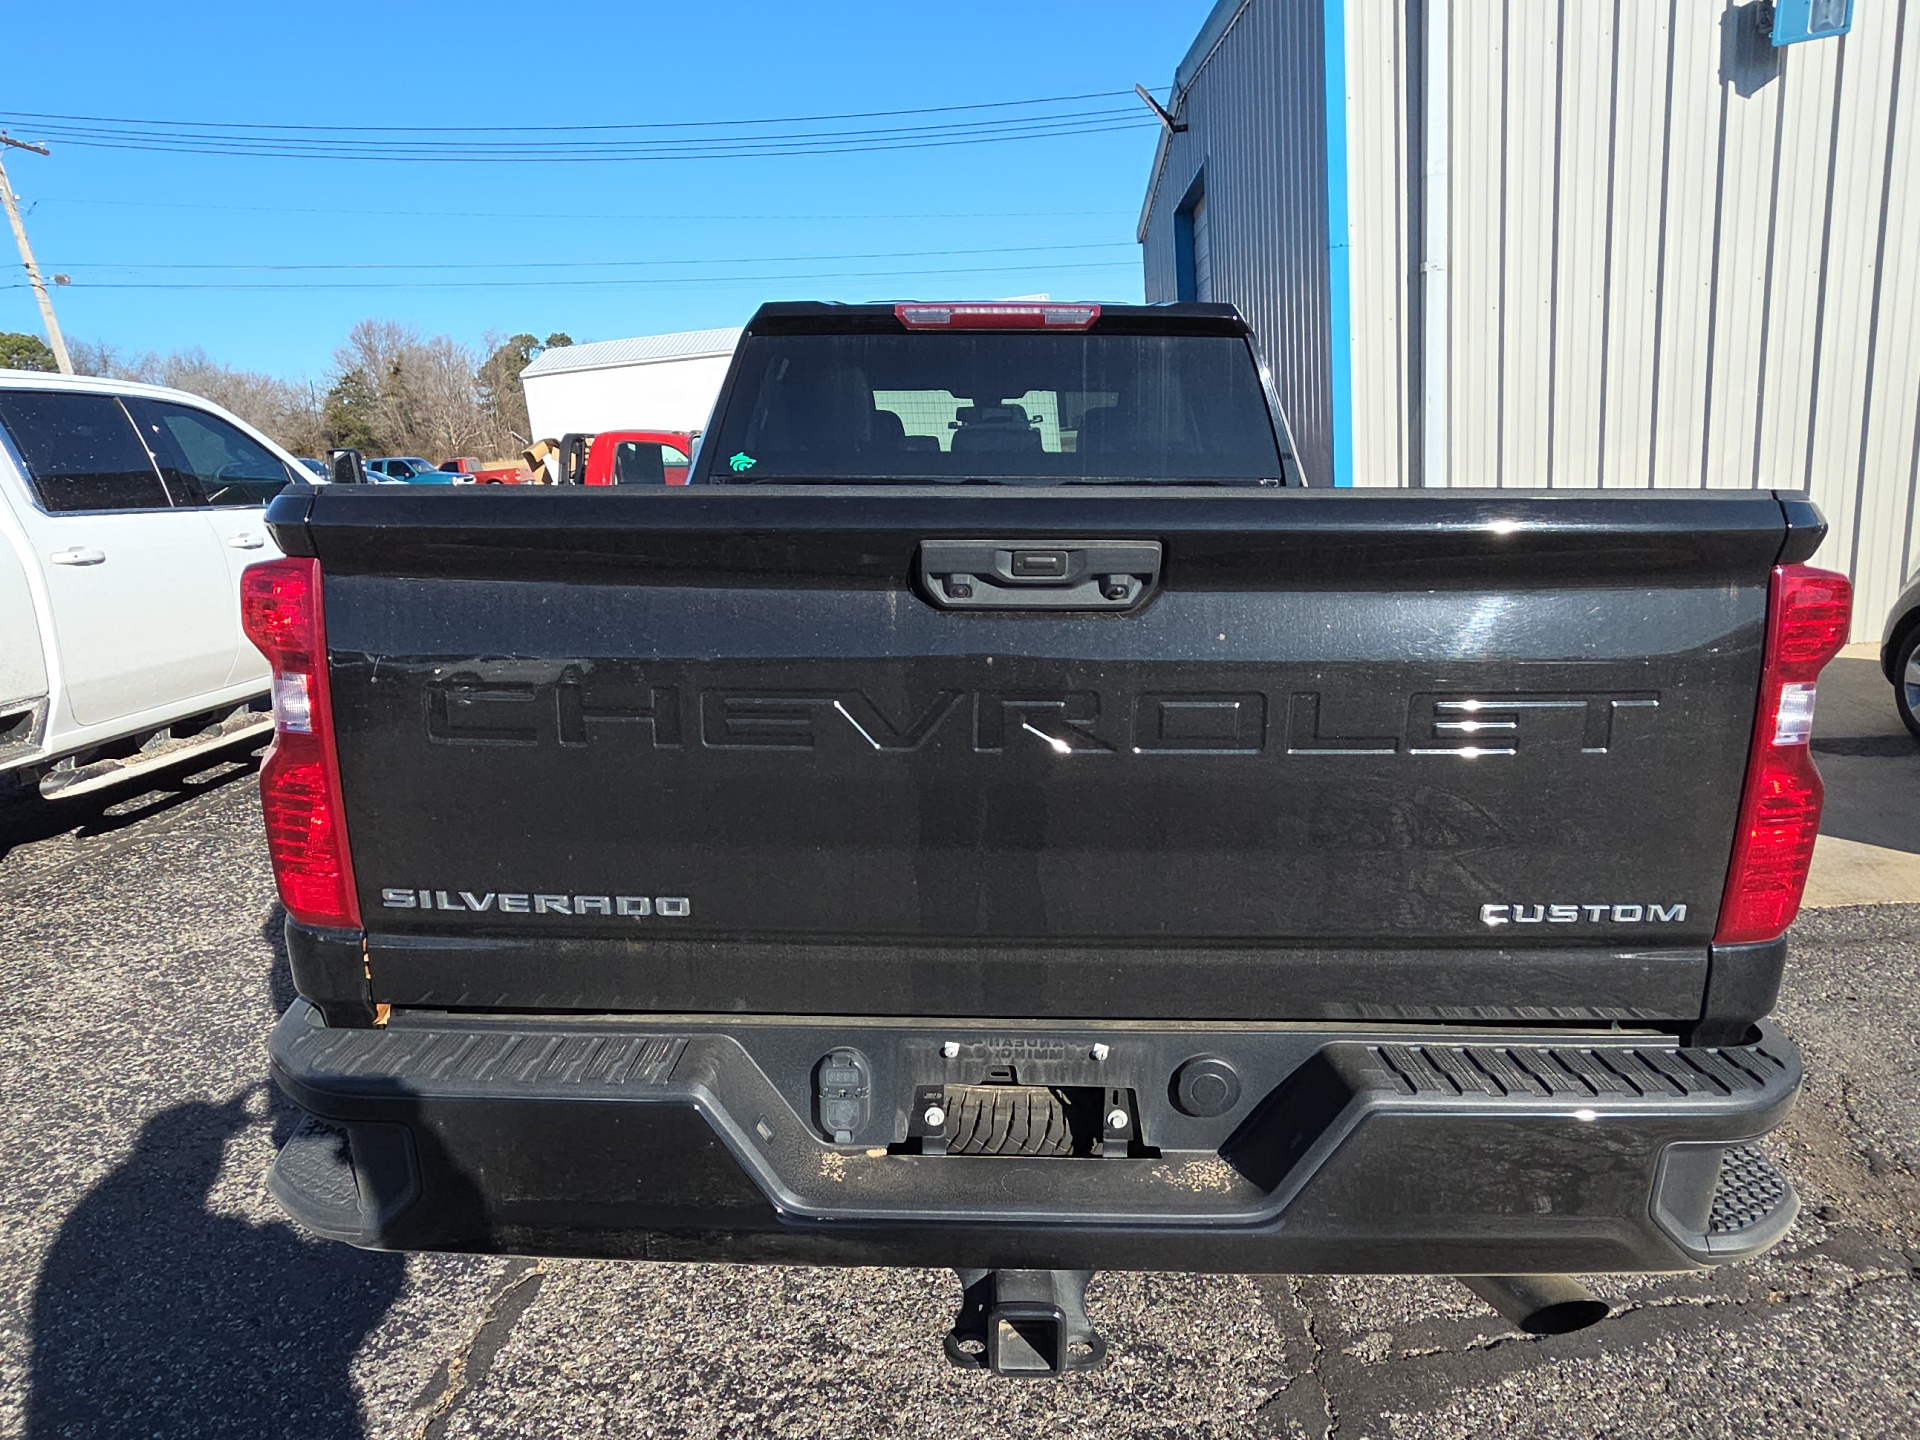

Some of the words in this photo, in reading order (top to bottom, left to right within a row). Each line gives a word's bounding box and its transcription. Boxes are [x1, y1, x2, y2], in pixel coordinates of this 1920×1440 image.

[424, 682, 1661, 756] CHEVROLET
[382, 887, 691, 917] SILVERADO
[1480, 903, 1688, 926] CUSTOM
